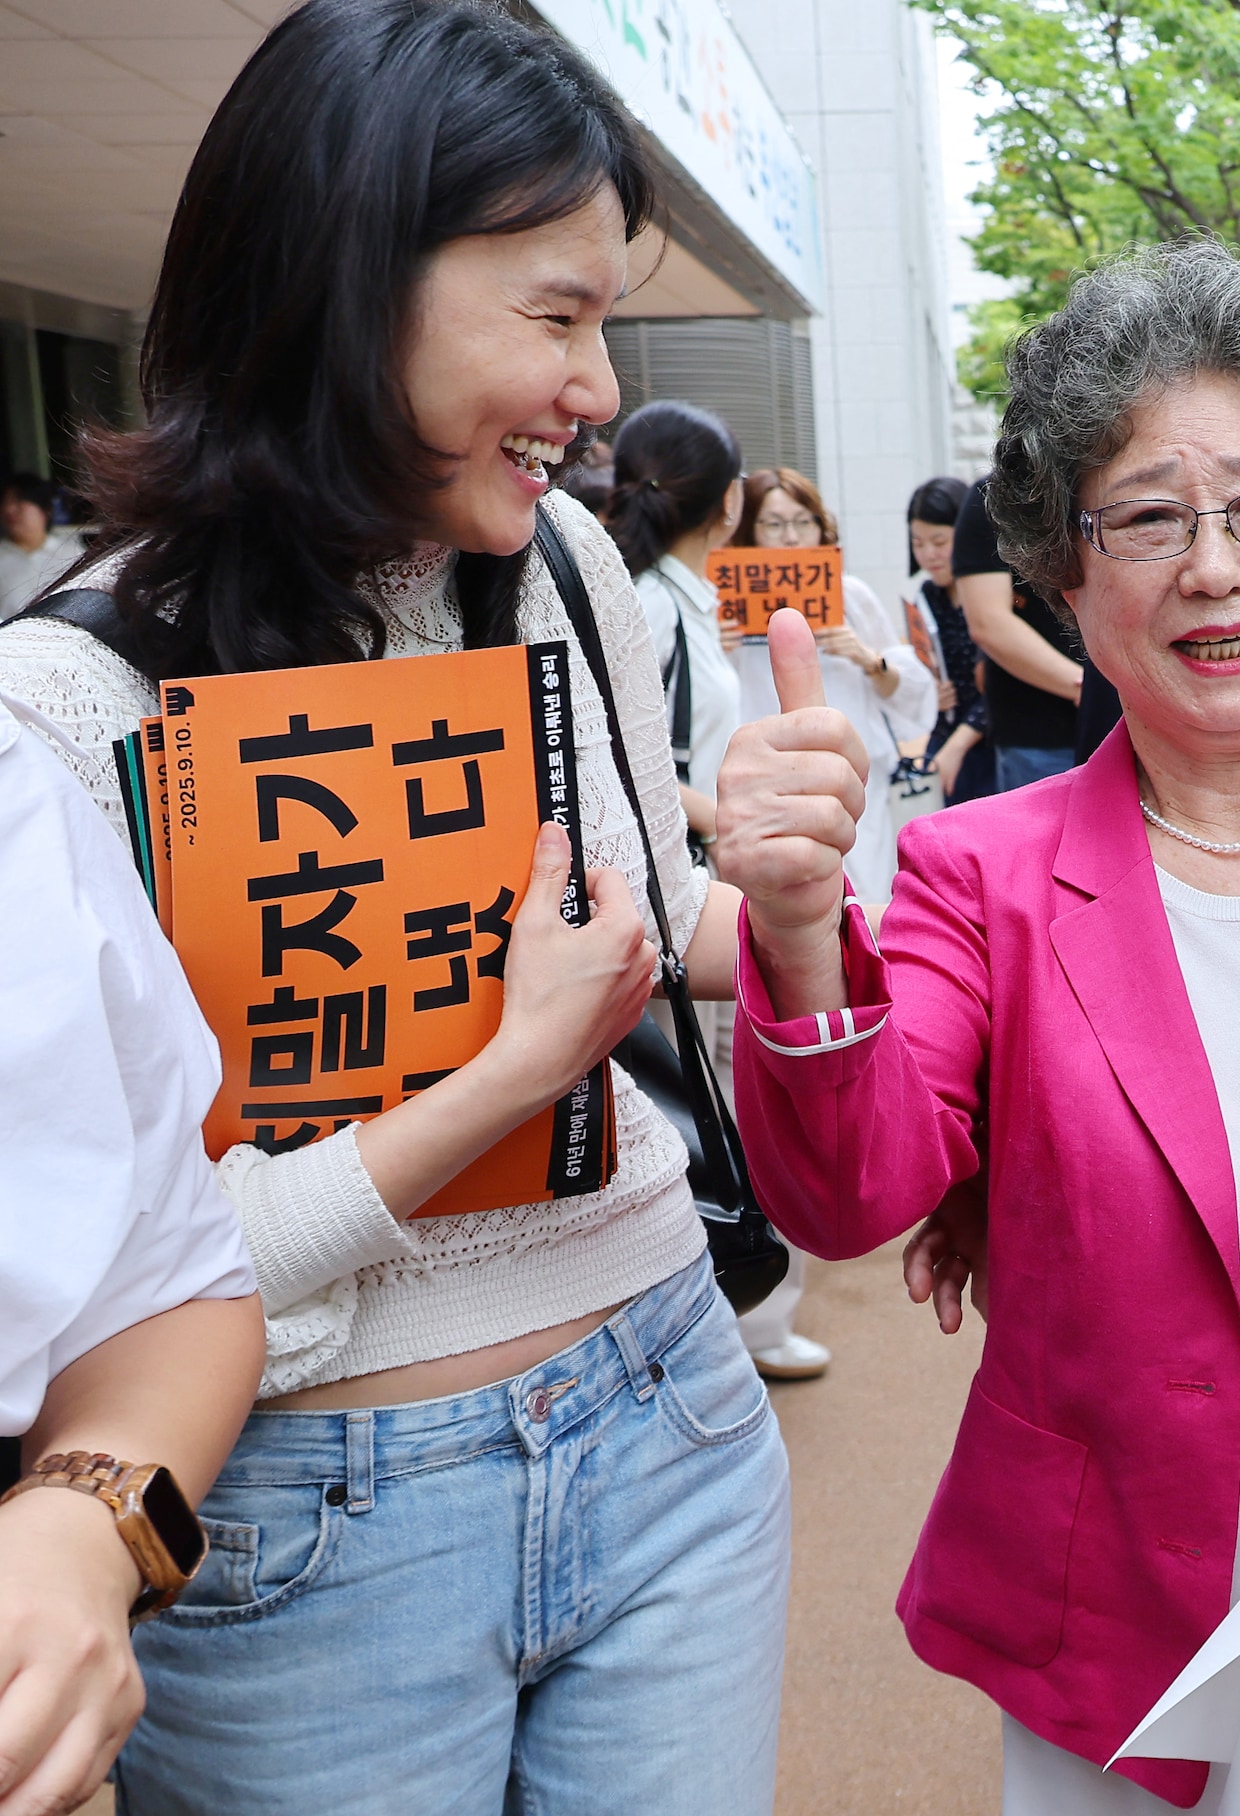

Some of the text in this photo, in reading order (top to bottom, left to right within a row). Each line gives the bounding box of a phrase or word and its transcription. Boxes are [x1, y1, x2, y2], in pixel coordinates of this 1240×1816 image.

[714, 561, 833, 594] 최말자가
[540, 653, 559, 690] 승리
[543, 693, 564, 747] 이뤄낸
[175, 721, 197, 829] 2025.9.10.
[547, 748, 568, 802] 최초로
[568, 1112, 589, 1144] 만에
[565, 1144, 586, 1178] 61년
